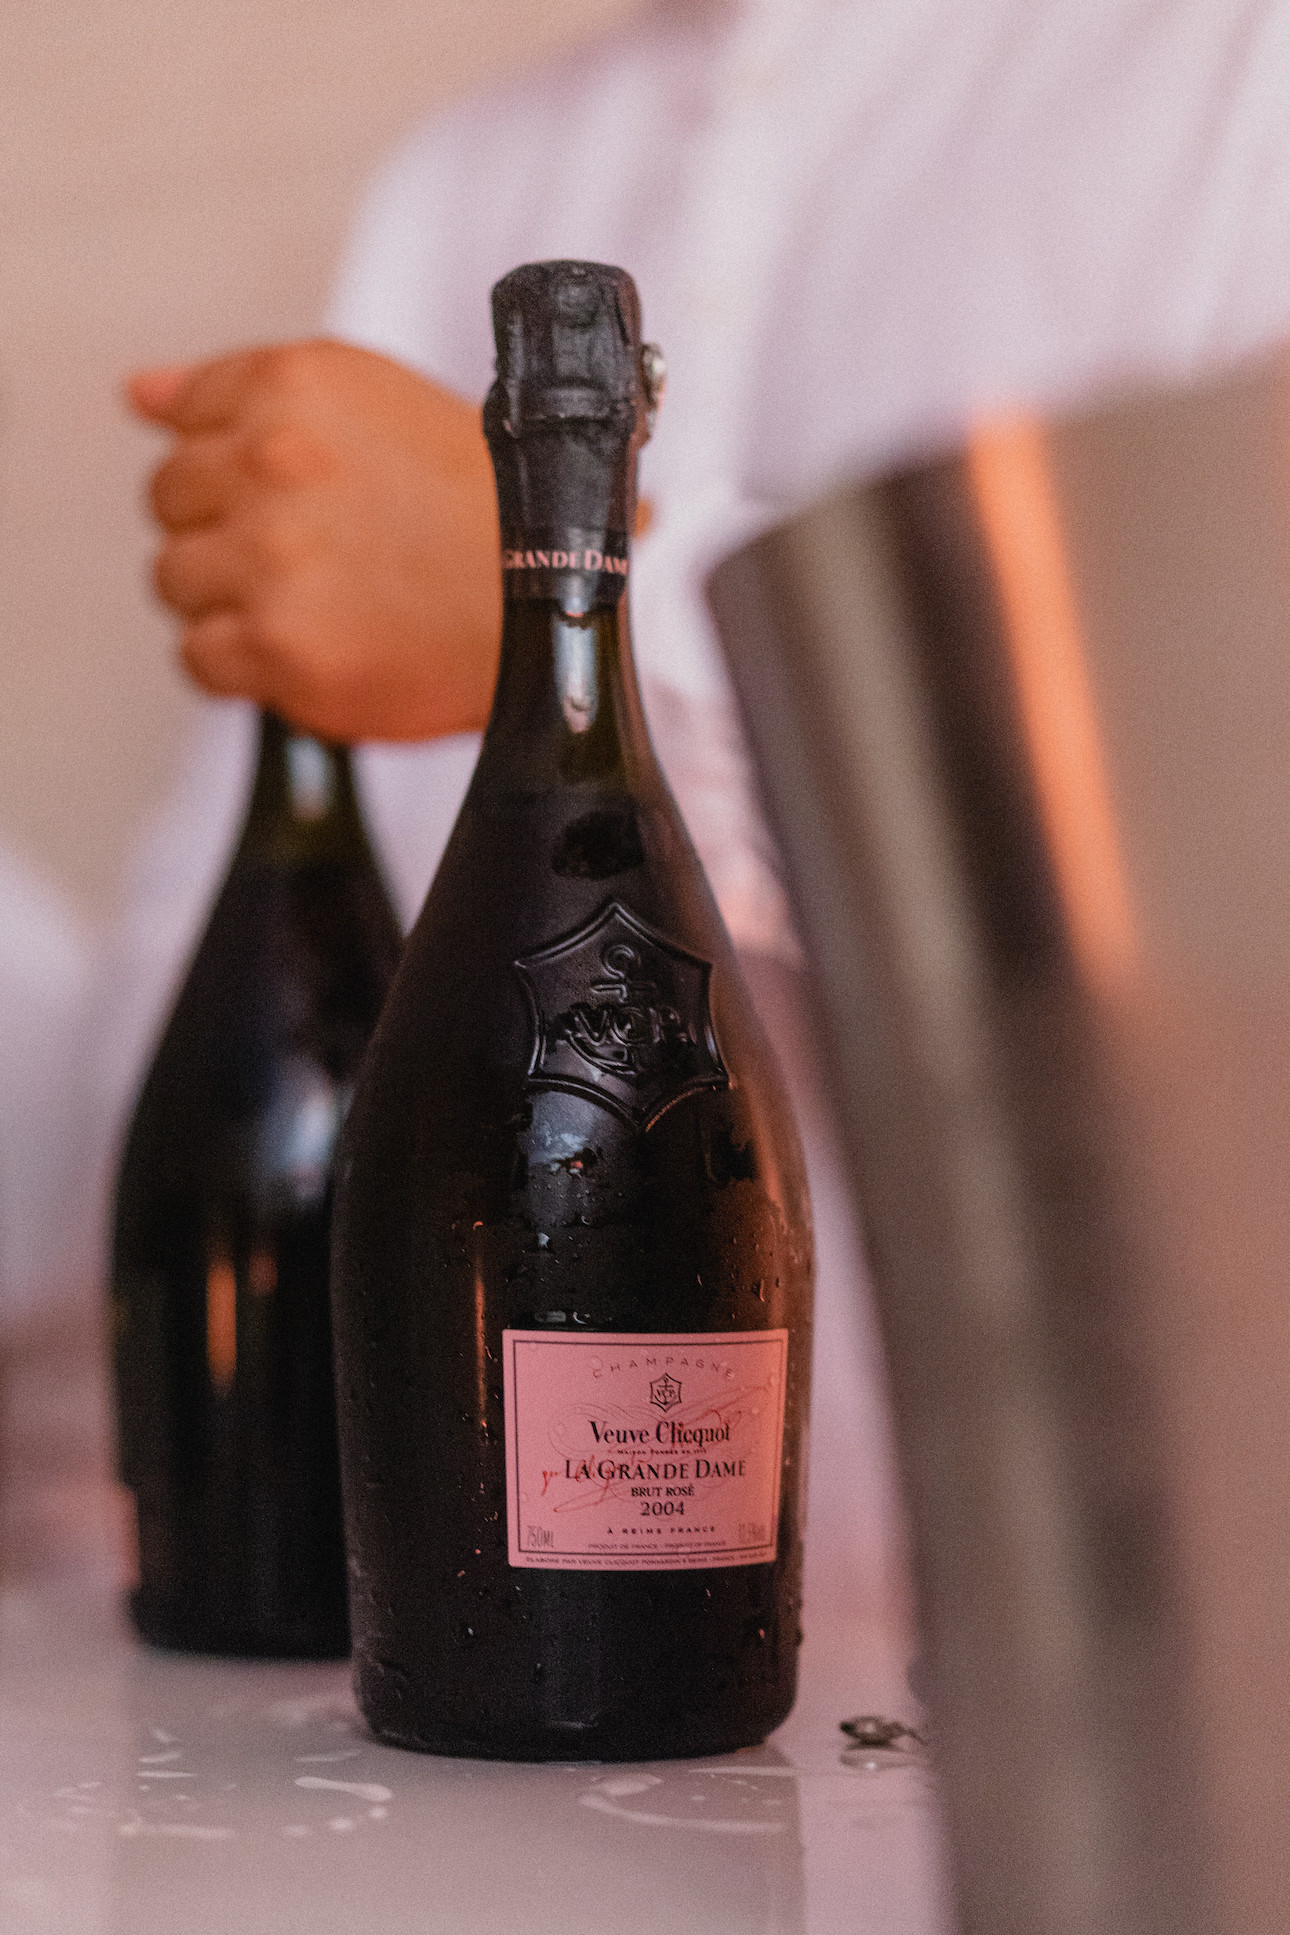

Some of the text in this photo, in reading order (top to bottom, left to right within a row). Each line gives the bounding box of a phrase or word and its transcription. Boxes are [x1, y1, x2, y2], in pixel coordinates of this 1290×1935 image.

[593, 1356, 735, 1378] CHAMPAGNE
[589, 1420, 730, 1447] Veuve Clicquot
[566, 1458, 745, 1480] LA GRANDE DAME
[631, 1481, 695, 1497] BRUT ROSÉ
[640, 1501, 685, 1516] 2004
[670, 1525, 715, 1534] FRANCE
